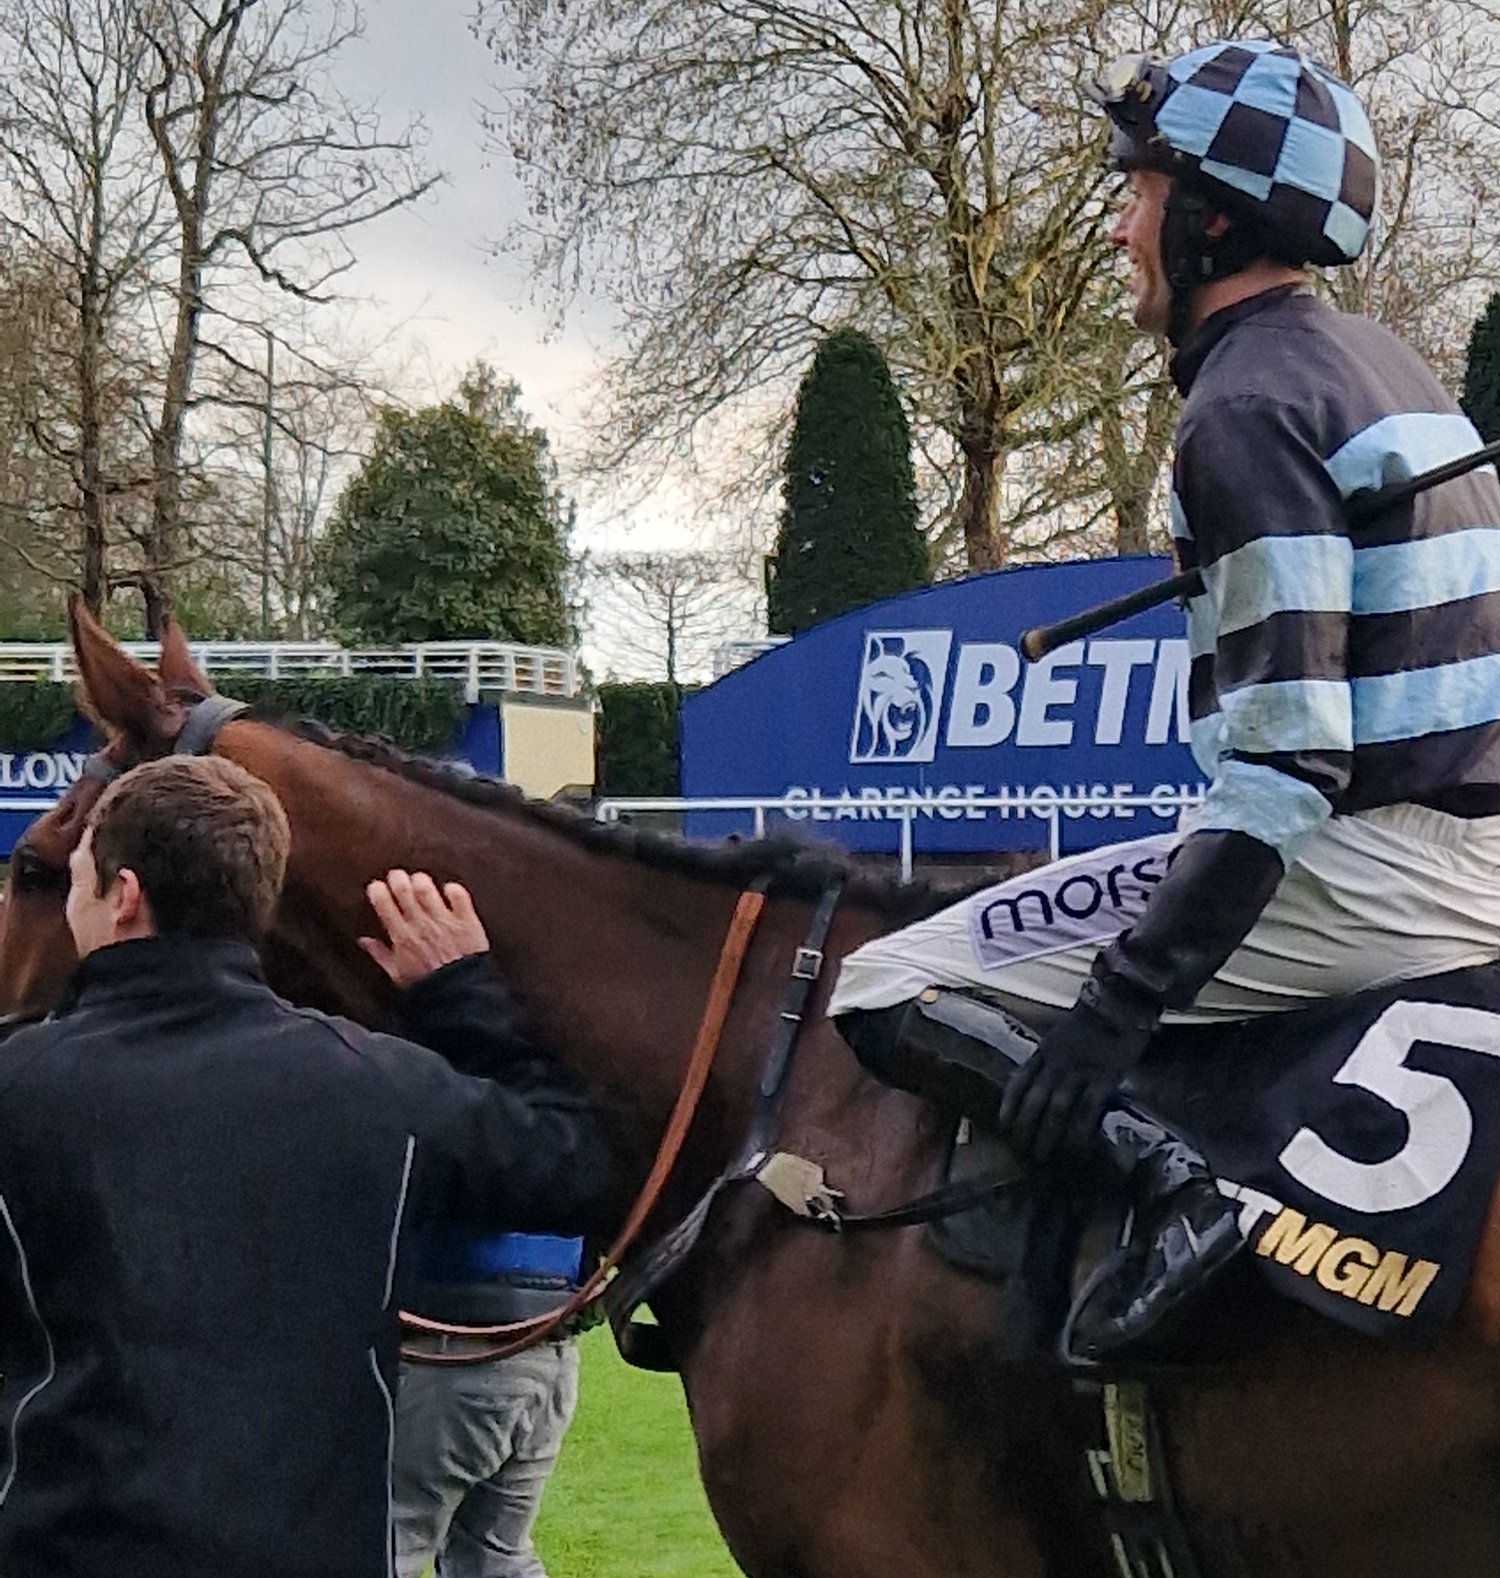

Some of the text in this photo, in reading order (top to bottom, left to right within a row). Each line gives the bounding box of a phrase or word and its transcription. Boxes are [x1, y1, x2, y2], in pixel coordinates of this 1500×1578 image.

[784, 786, 987, 820] CLARENCE
[1000, 784, 1135, 819] HOUSE
[981, 843, 1184, 939] mors
[1216, 1177, 1441, 1317] TMGM
